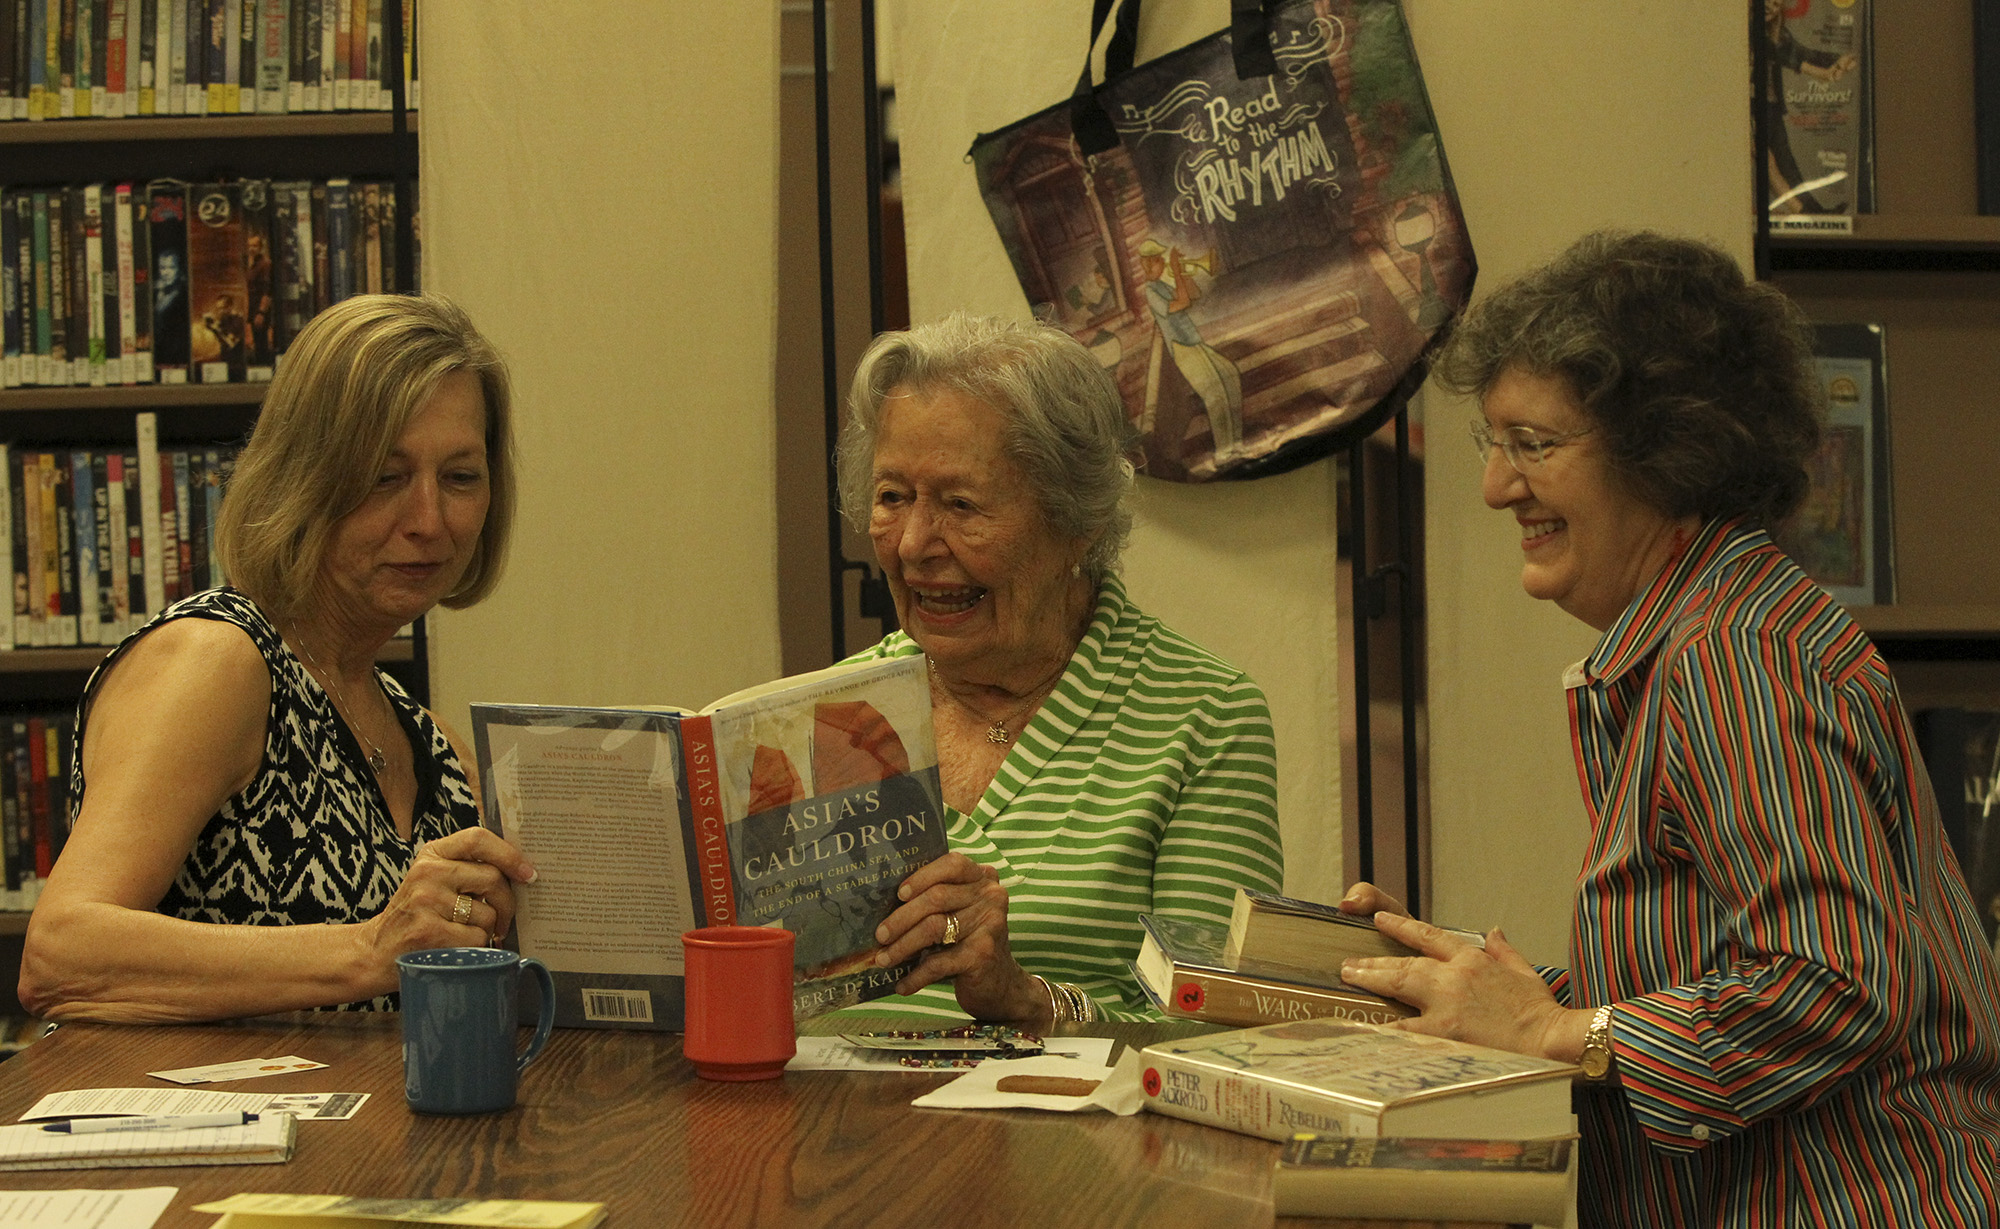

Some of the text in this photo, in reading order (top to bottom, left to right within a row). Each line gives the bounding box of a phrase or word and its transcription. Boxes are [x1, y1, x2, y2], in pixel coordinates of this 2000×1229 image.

[1204, 74, 1282, 143] Read
[1218, 122, 1279, 155] to the
[1195, 121, 1334, 224] RHYTHM
[1784, 221, 1847, 230] MAGAZINE
[162, 510, 180, 584] VALKYRIE
[807, 691, 821, 701] THE
[825, 683, 859, 695] REVENGE
[872, 668, 916, 683] GEOGRAPHY
[570, 752, 622, 761] CAULDRON
[692, 740, 731, 927] ASIA'S CAULDRO
[782, 789, 881, 836] ASIA'S
[744, 811, 927, 881] CAULDRON
[753, 859, 930, 918] THE END OF A STABLE PACIFIC
[758, 846, 919, 899] THE SOUTH CHINA SEA AND
[793, 987, 837, 1011] BERT
[868, 965, 914, 989] KAP
[1252, 989, 1313, 1022] WARS
[1334, 1005, 1405, 1024] ROSE
[1166, 1068, 1201, 1093] PETER
